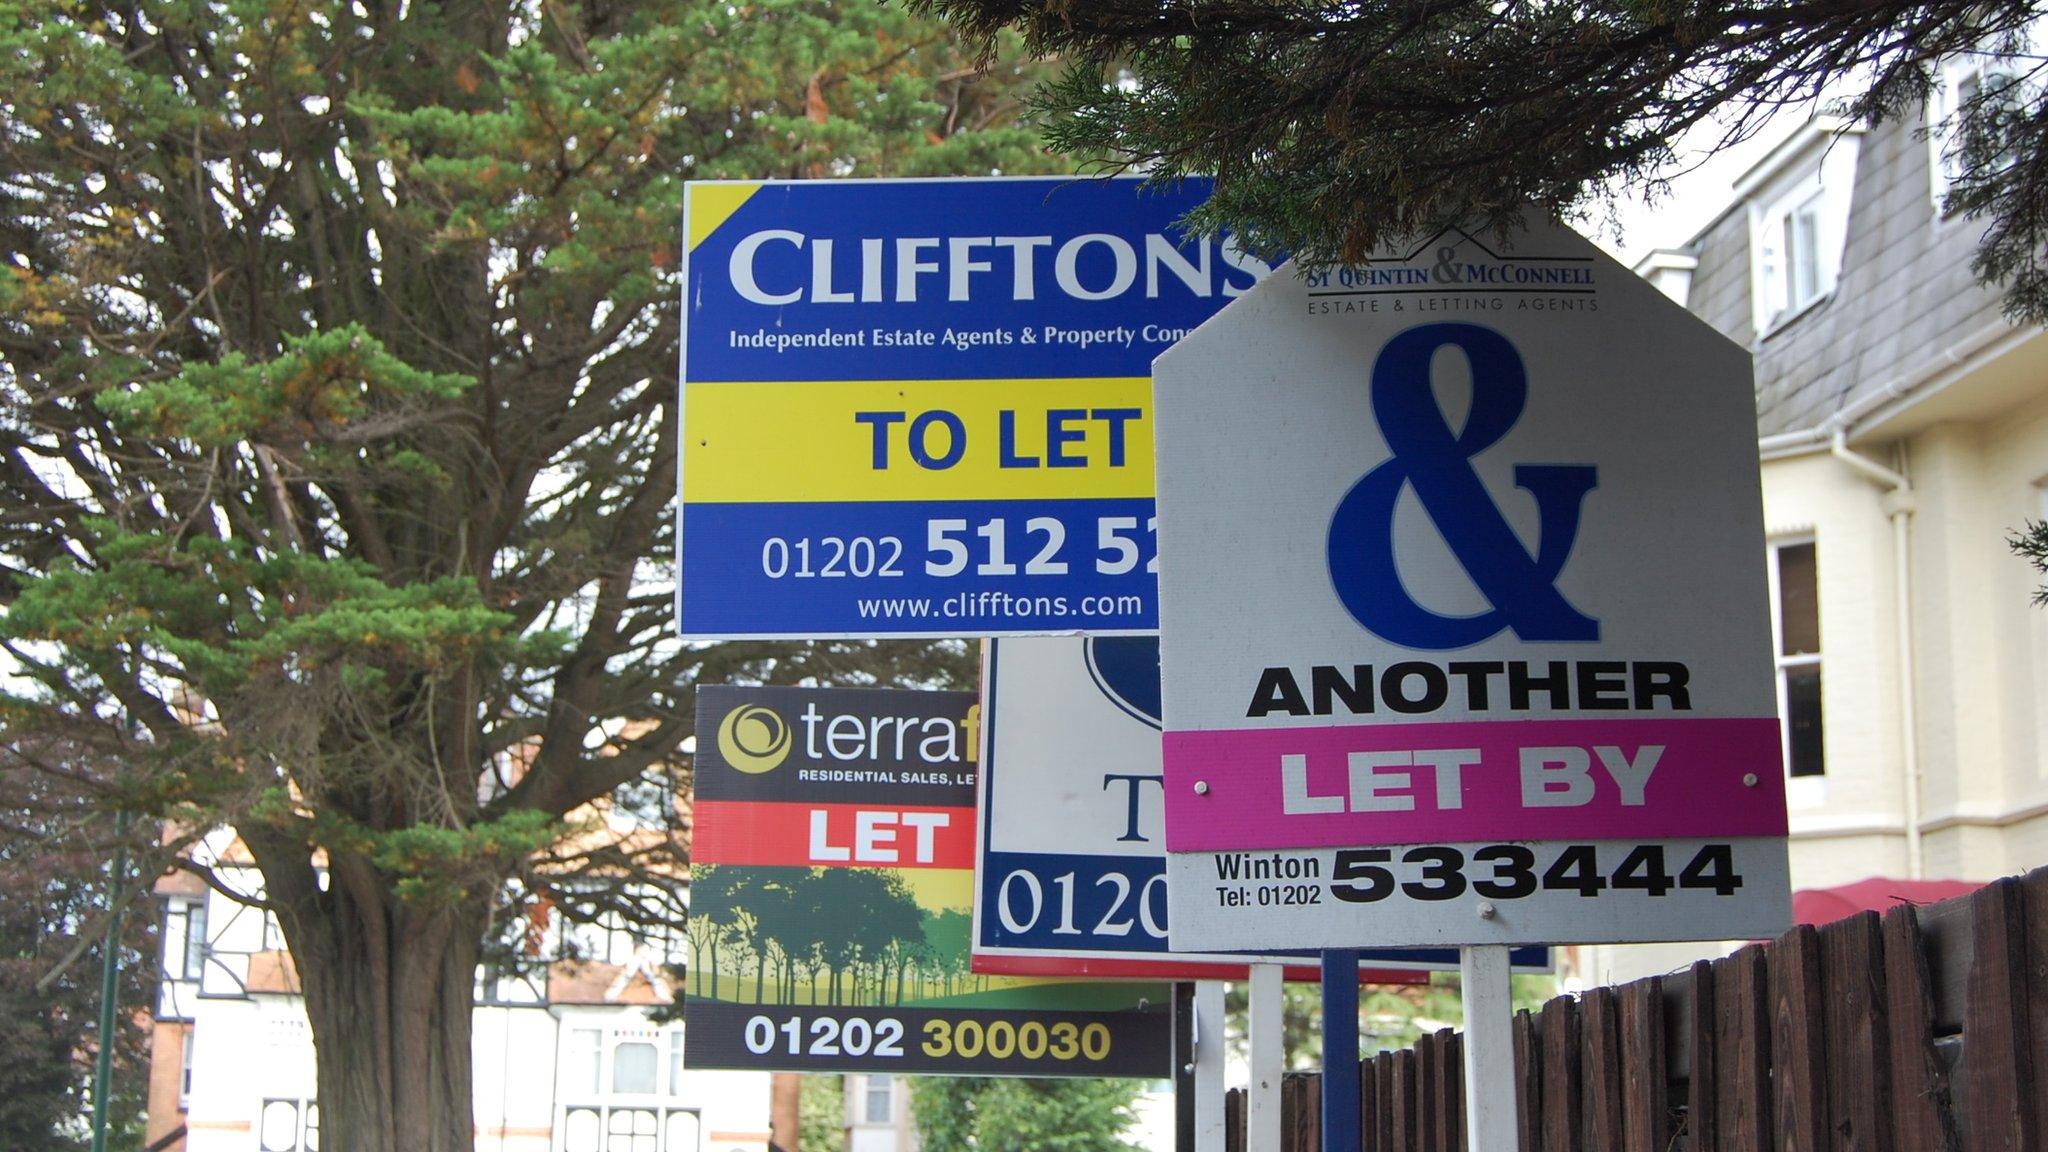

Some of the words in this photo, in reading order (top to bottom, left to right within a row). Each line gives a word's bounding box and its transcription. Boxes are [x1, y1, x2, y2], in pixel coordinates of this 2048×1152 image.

[729, 229, 1272, 305] CLIFFTONS
[1432, 246, 1463, 284] &
[1308, 300, 1379, 314] ESTATE
[1394, 299, 1404, 312] &
[1419, 298, 1503, 312] LETTING
[1517, 298, 1598, 312] AGENTS
[730, 328, 865, 352] Independent
[873, 328, 934, 346] Estate
[942, 328, 1012, 350] Agents
[1020, 326, 1037, 344] &
[1045, 325, 1135, 348] Property
[855, 410, 967, 471] TO
[1000, 408, 1142, 468] LET
[1326, 320, 1601, 651] &
[762, 536, 904, 579] 01202
[925, 517, 1069, 577] 512
[1096, 516, 1158, 575] 5
[857, 592, 1142, 618] www.clifftons.com
[1245, 661, 1692, 718] ANOTHER
[801, 702, 980, 763] terraf
[799, 769, 897, 783] RESIDENTIAL
[901, 772, 952, 786] SALES,
[957, 774, 978, 785] LE
[1281, 748, 1482, 815] LET
[1519, 745, 1666, 808] BY
[809, 810, 950, 864] LET
[1215, 853, 1320, 880] Winton
[1330, 845, 1743, 903] 533444
[1216, 887, 1251, 906] Tel:
[1258, 885, 1322, 906] 01202
[744, 1015, 905, 1057] 01202
[921, 1018, 1112, 1061] 300030
